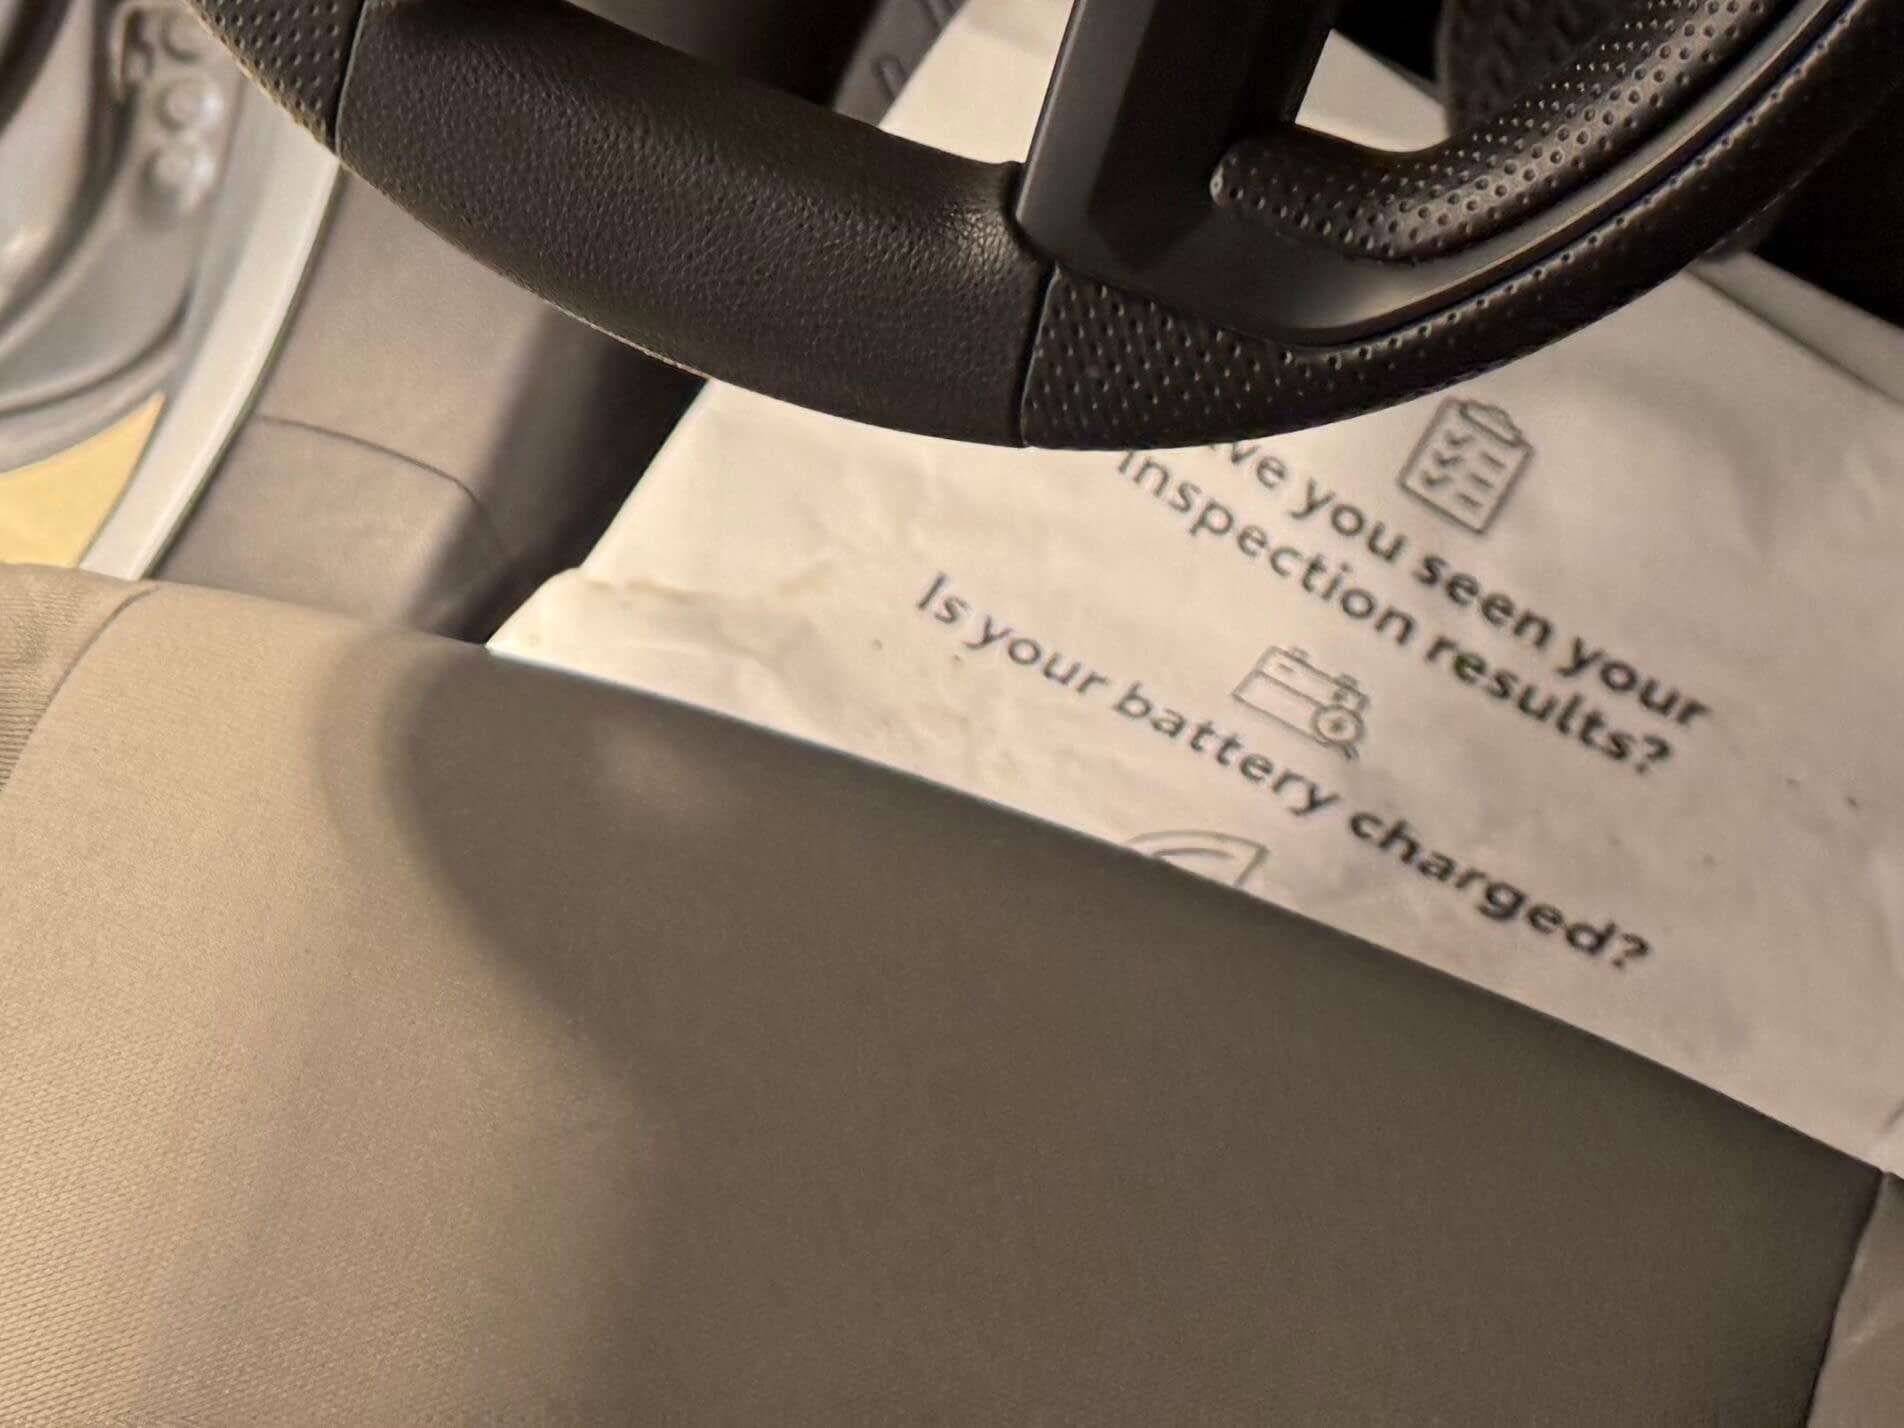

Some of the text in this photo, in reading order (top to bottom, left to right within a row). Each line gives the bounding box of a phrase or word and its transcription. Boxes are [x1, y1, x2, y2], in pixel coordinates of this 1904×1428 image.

[1116, 447, 1676, 776] inspection results?
[1204, 441, 1714, 731] ve you seen your
[916, 572, 1653, 973] Is your battery charged?
